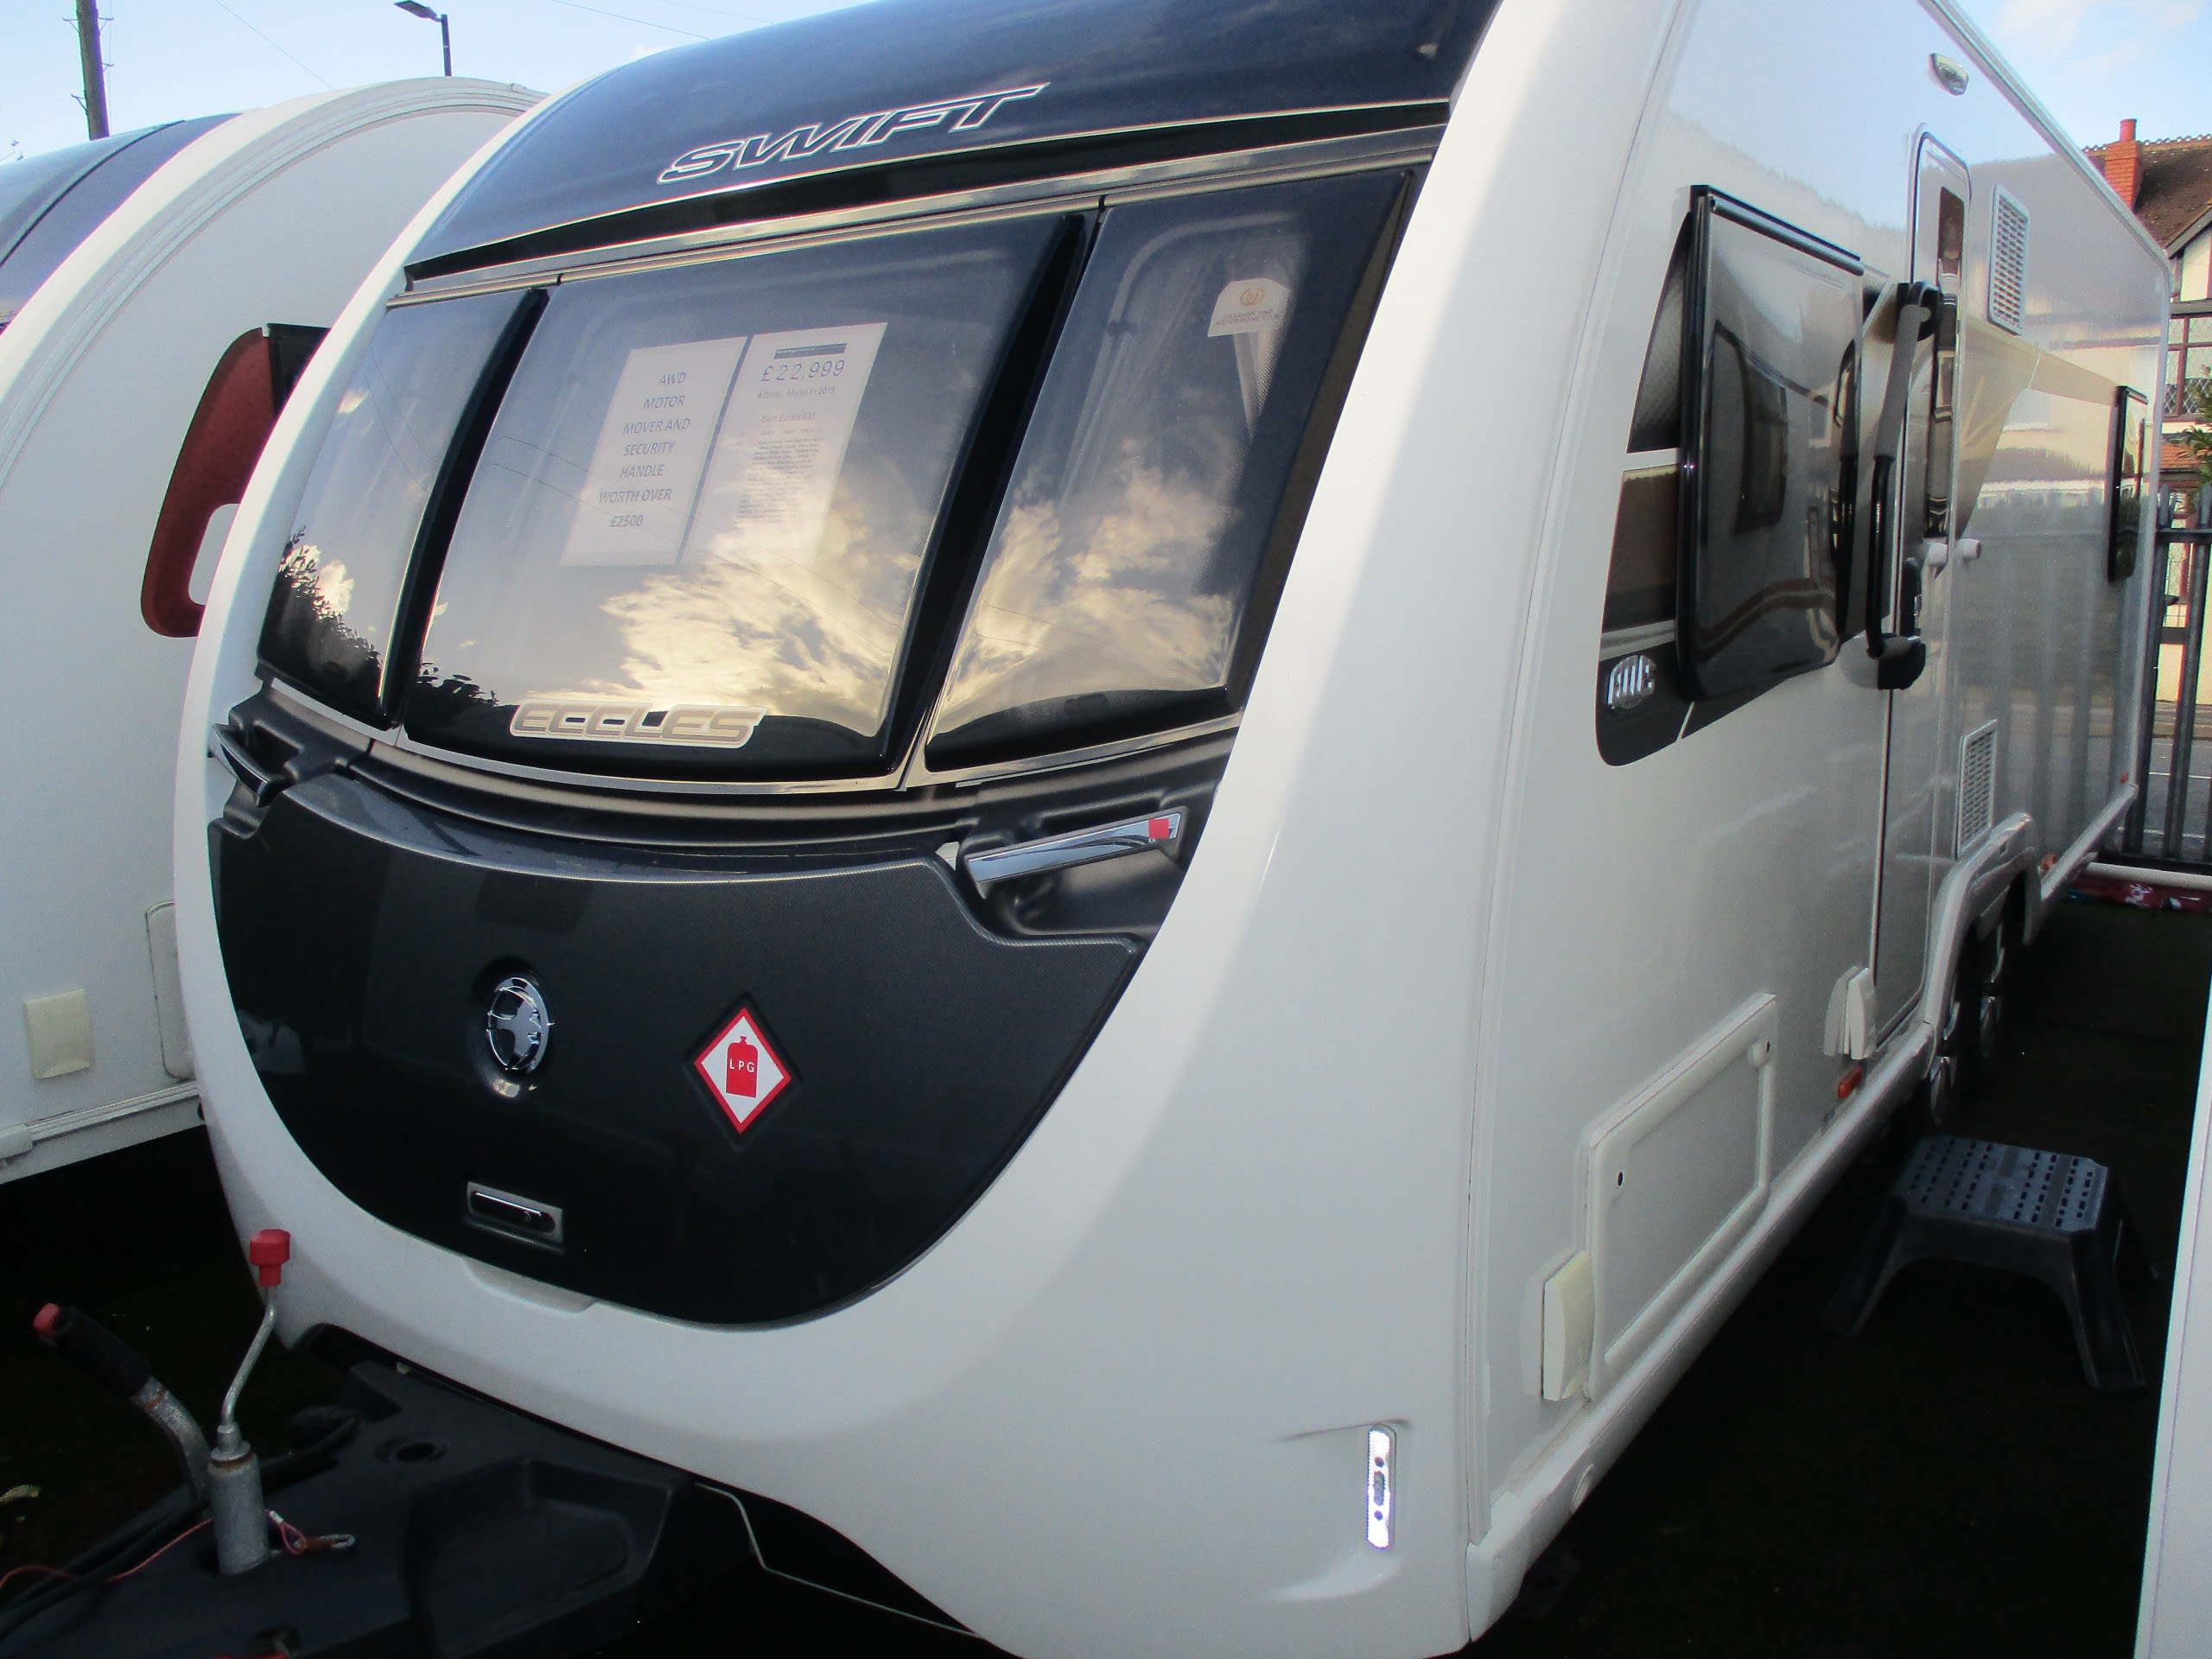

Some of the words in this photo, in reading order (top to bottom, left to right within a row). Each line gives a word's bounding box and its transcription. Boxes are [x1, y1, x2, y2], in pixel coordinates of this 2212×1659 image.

[657, 82, 1051, 184] SWIFT
[658, 372, 686, 385] AWD
[644, 396, 685, 410] MOTOR
[623, 421, 664, 435] MOVER
[664, 418, 690, 431] AND
[623, 441, 676, 456] SECURITY
[620, 464, 665, 478] HANDLE
[599, 490, 640, 504] WORTH
[641, 488, 671, 502] OVER
[608, 514, 644, 528] £2500
[510, 699, 767, 748] ECCLES
[728, 1058, 754, 1073] LPG
